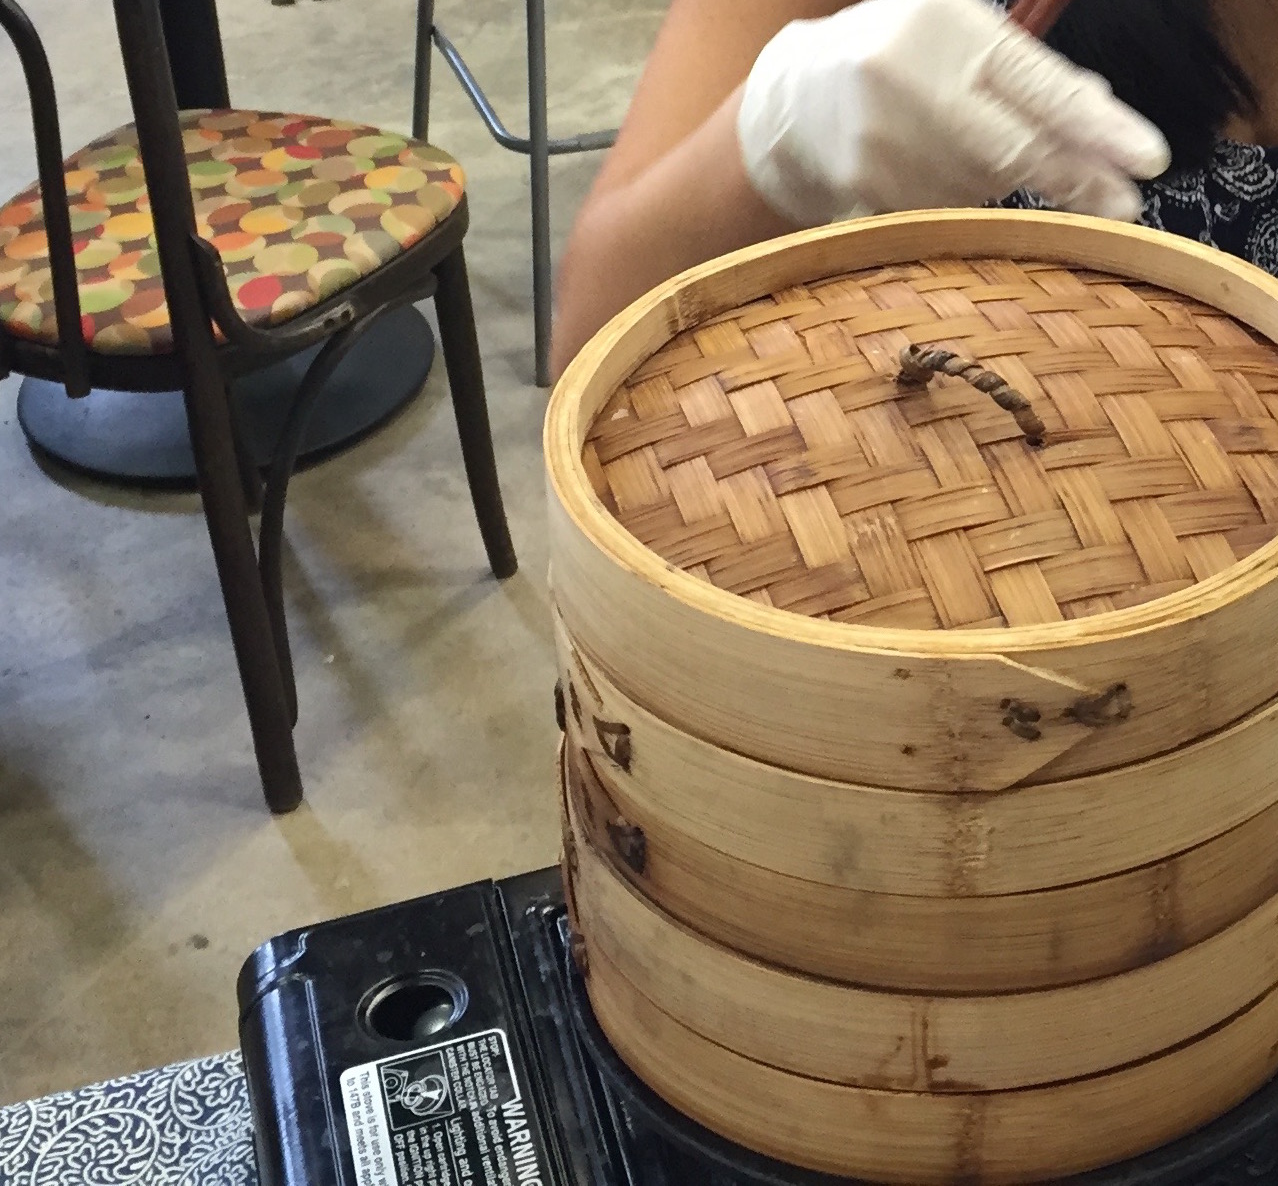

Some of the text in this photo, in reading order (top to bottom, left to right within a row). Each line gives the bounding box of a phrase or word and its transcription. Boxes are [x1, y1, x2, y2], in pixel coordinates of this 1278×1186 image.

[448, 1116, 468, 1157] Lighting
[458, 1158, 473, 1177] and
[471, 1110, 490, 1154] additional
